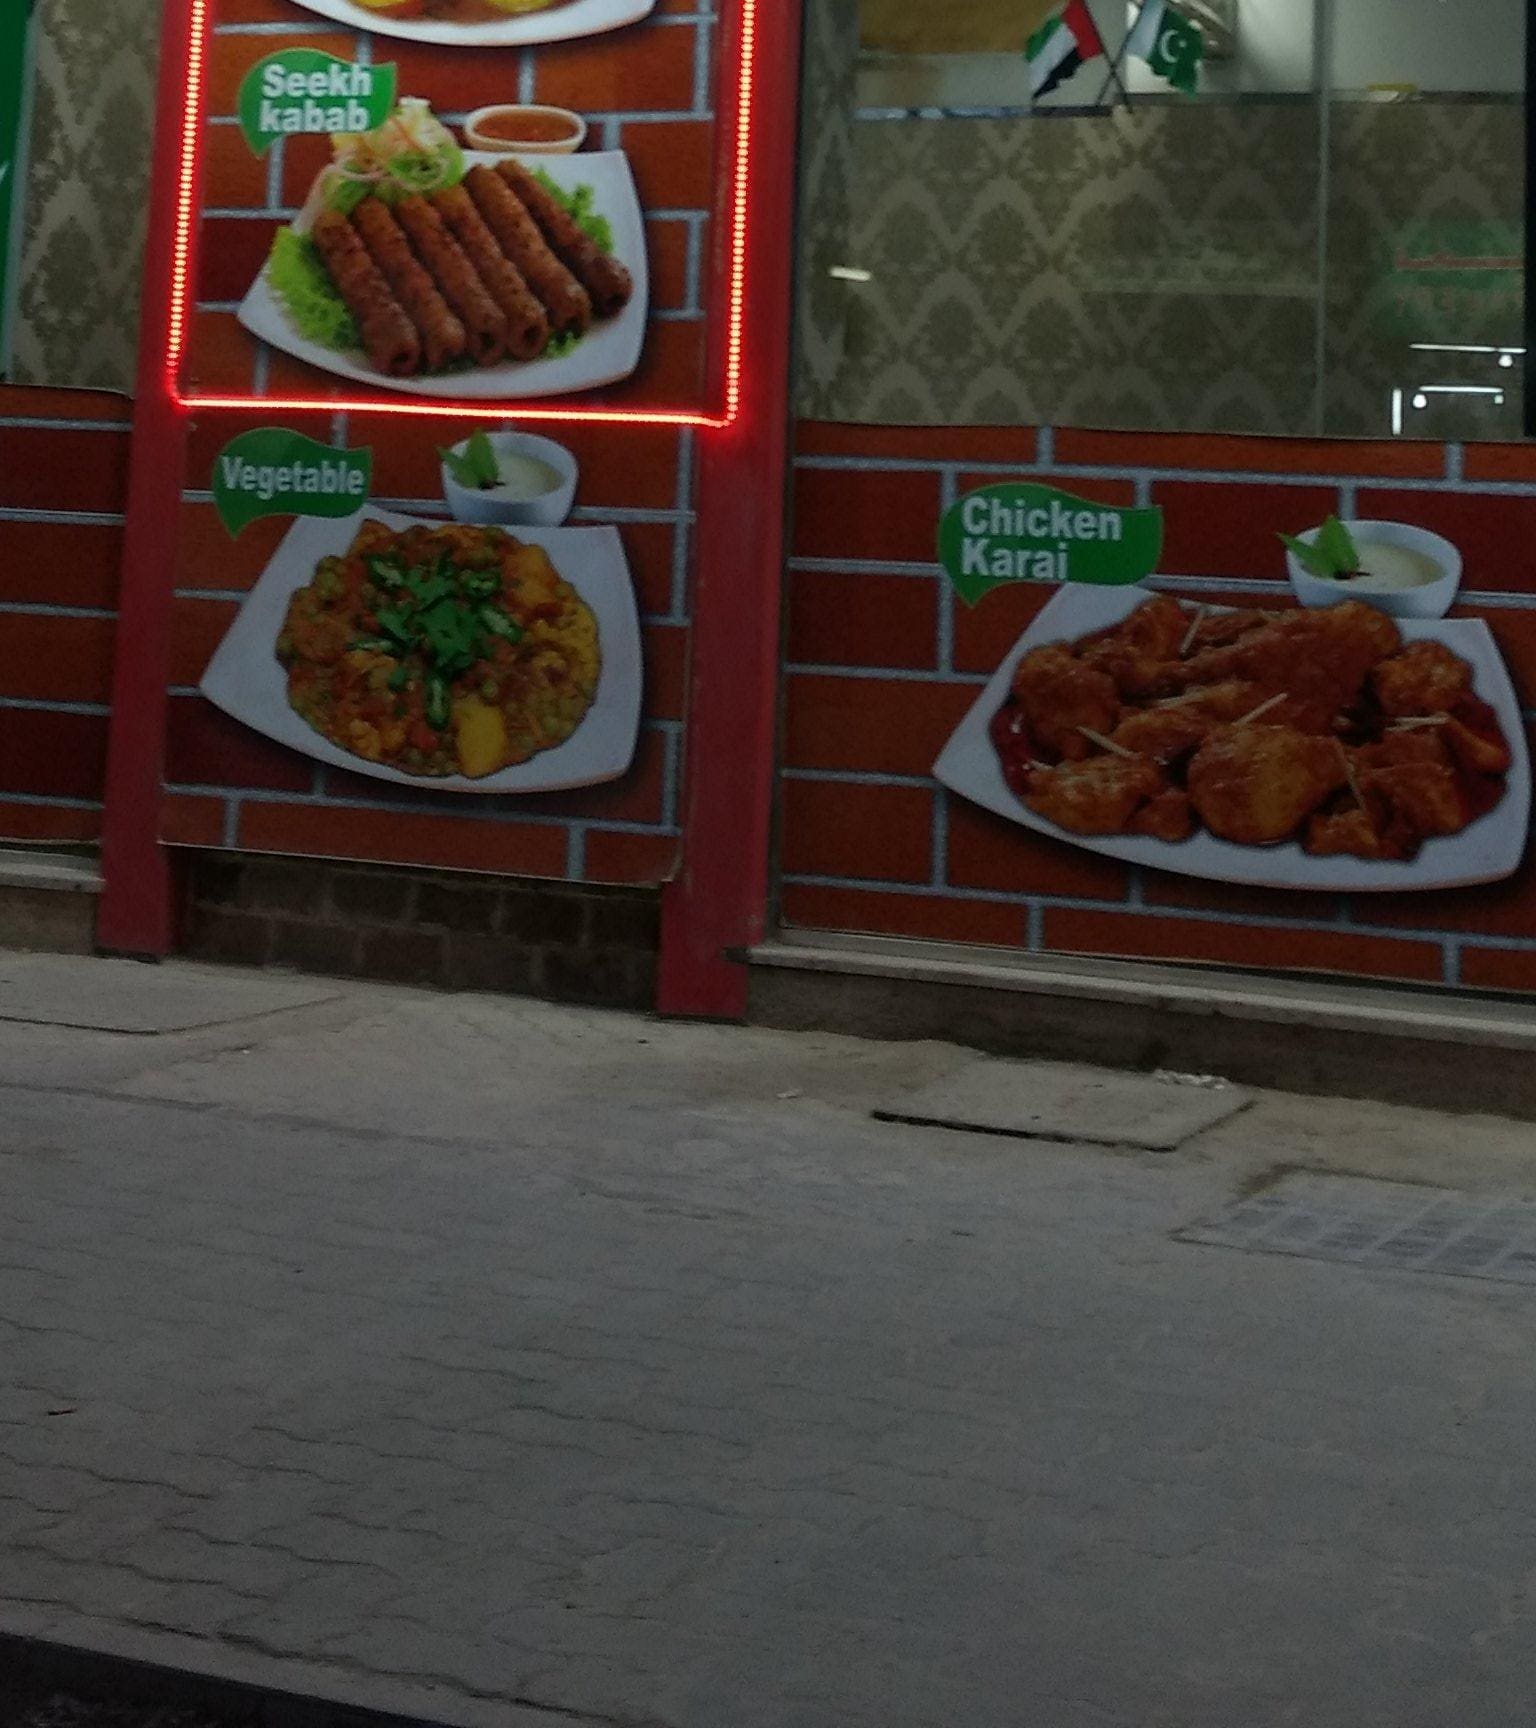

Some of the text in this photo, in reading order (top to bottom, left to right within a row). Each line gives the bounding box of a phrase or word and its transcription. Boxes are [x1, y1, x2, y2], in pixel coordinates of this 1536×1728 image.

[261, 62, 371, 98] Seekh
[260, 99, 368, 133] kabab
[220, 456, 364, 499] Vegetable
[962, 496, 1122, 540] Chicken
[962, 537, 1068, 579] Karai
